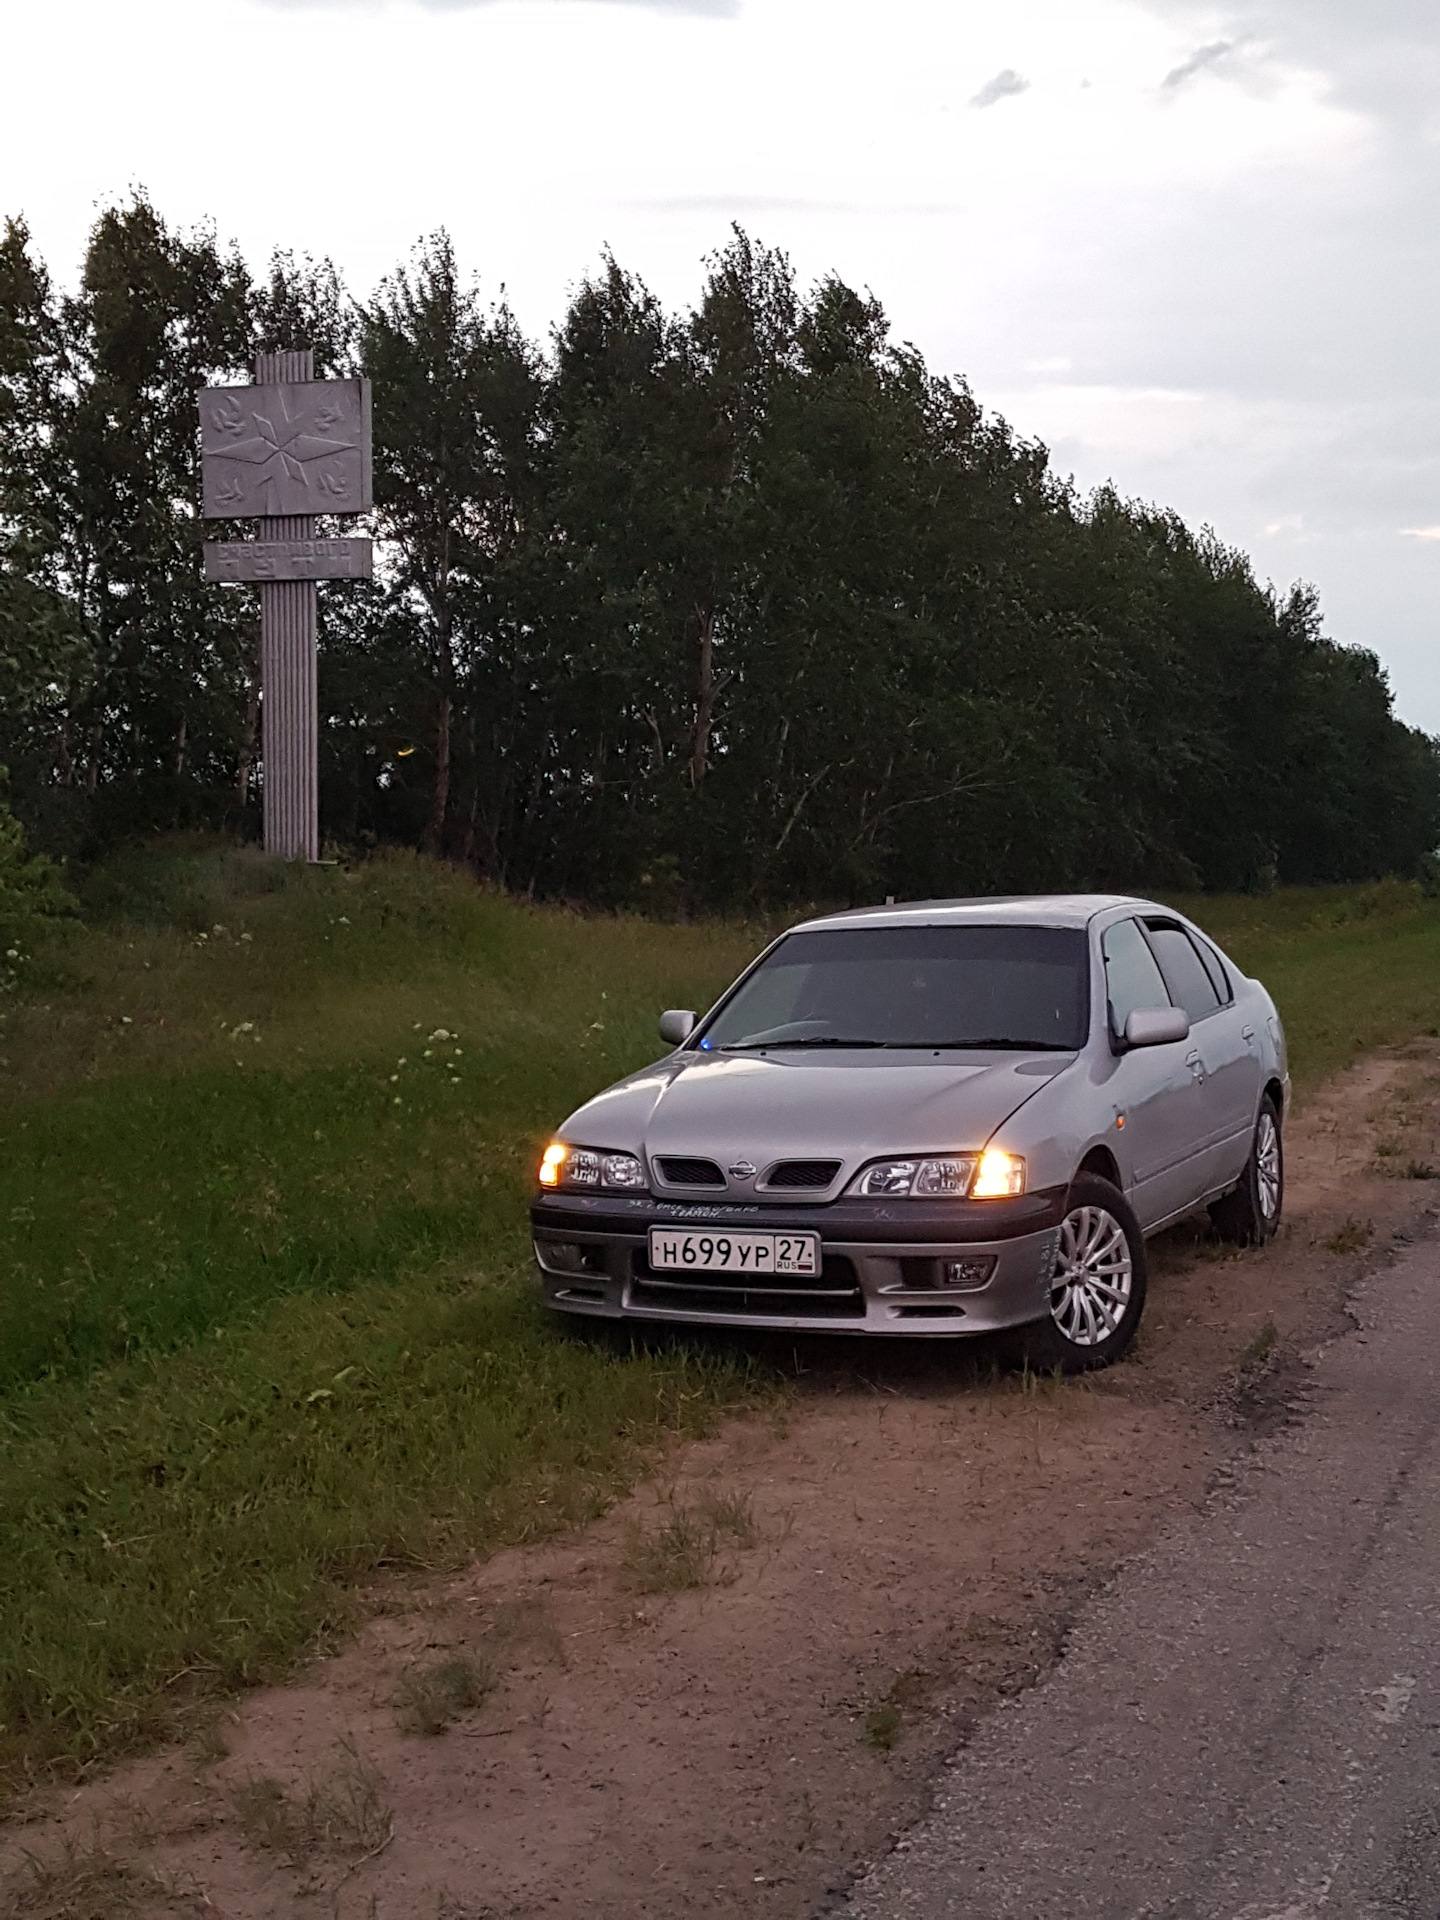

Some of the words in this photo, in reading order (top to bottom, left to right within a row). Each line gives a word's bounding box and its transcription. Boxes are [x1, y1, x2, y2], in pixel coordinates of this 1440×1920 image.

[663, 1237, 769, 1267] Н699УР
[779, 1240, 806, 1261] 27
[776, 1261, 797, 1270] RUS
